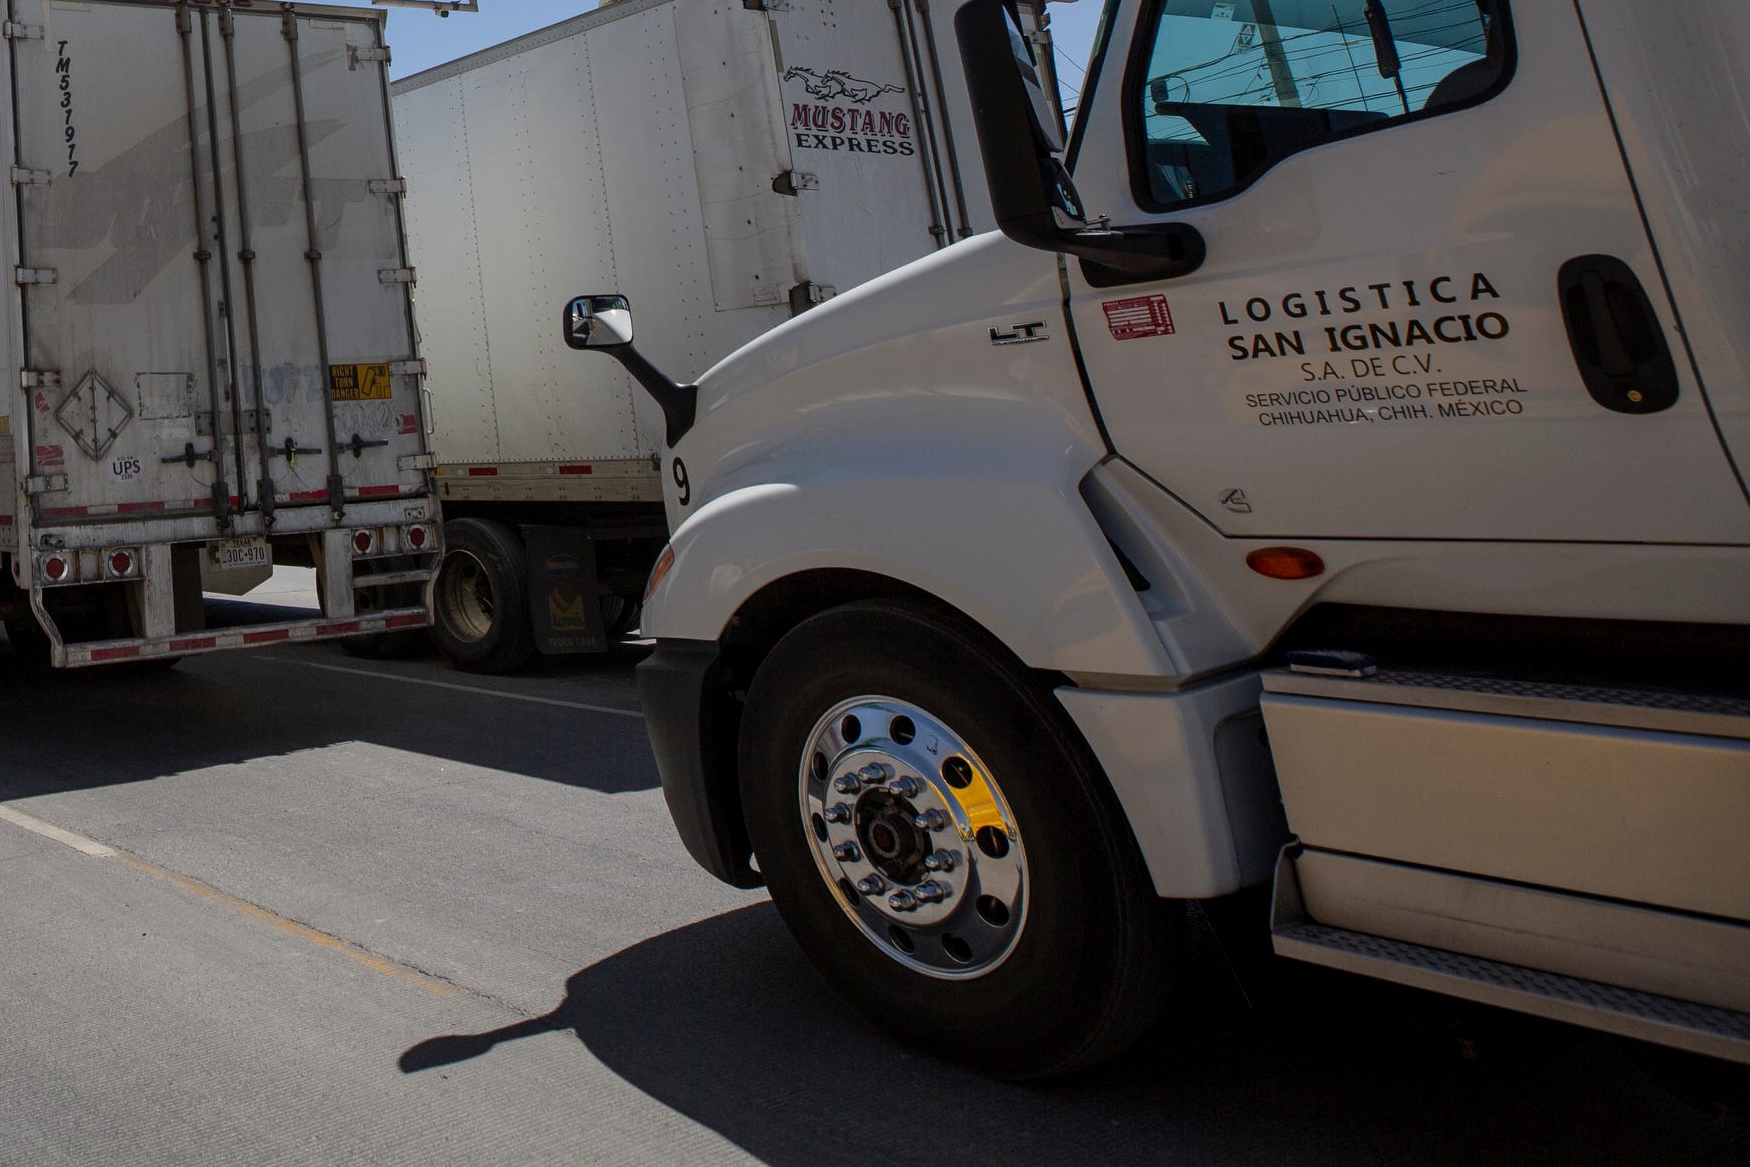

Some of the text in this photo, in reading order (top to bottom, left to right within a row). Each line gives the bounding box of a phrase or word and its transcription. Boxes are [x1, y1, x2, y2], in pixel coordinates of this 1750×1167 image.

[790, 103, 911, 137] MUSTANG
[795, 133, 915, 155] EXPRESS
[1218, 271, 1500, 326] LOGISTICA
[988, 321, 1046, 341] LT
[1227, 310, 1511, 361] SAN IGNACIO
[1300, 353, 1442, 382] S.A. DE C.V.
[1245, 377, 1527, 410] SERVICIO PÚBLICO FEDERAL
[1258, 396, 1523, 427] CHIHUAHUA, CHIH. MÉXICO
[112, 459, 141, 476] UPS
[672, 456, 691, 506] 9
